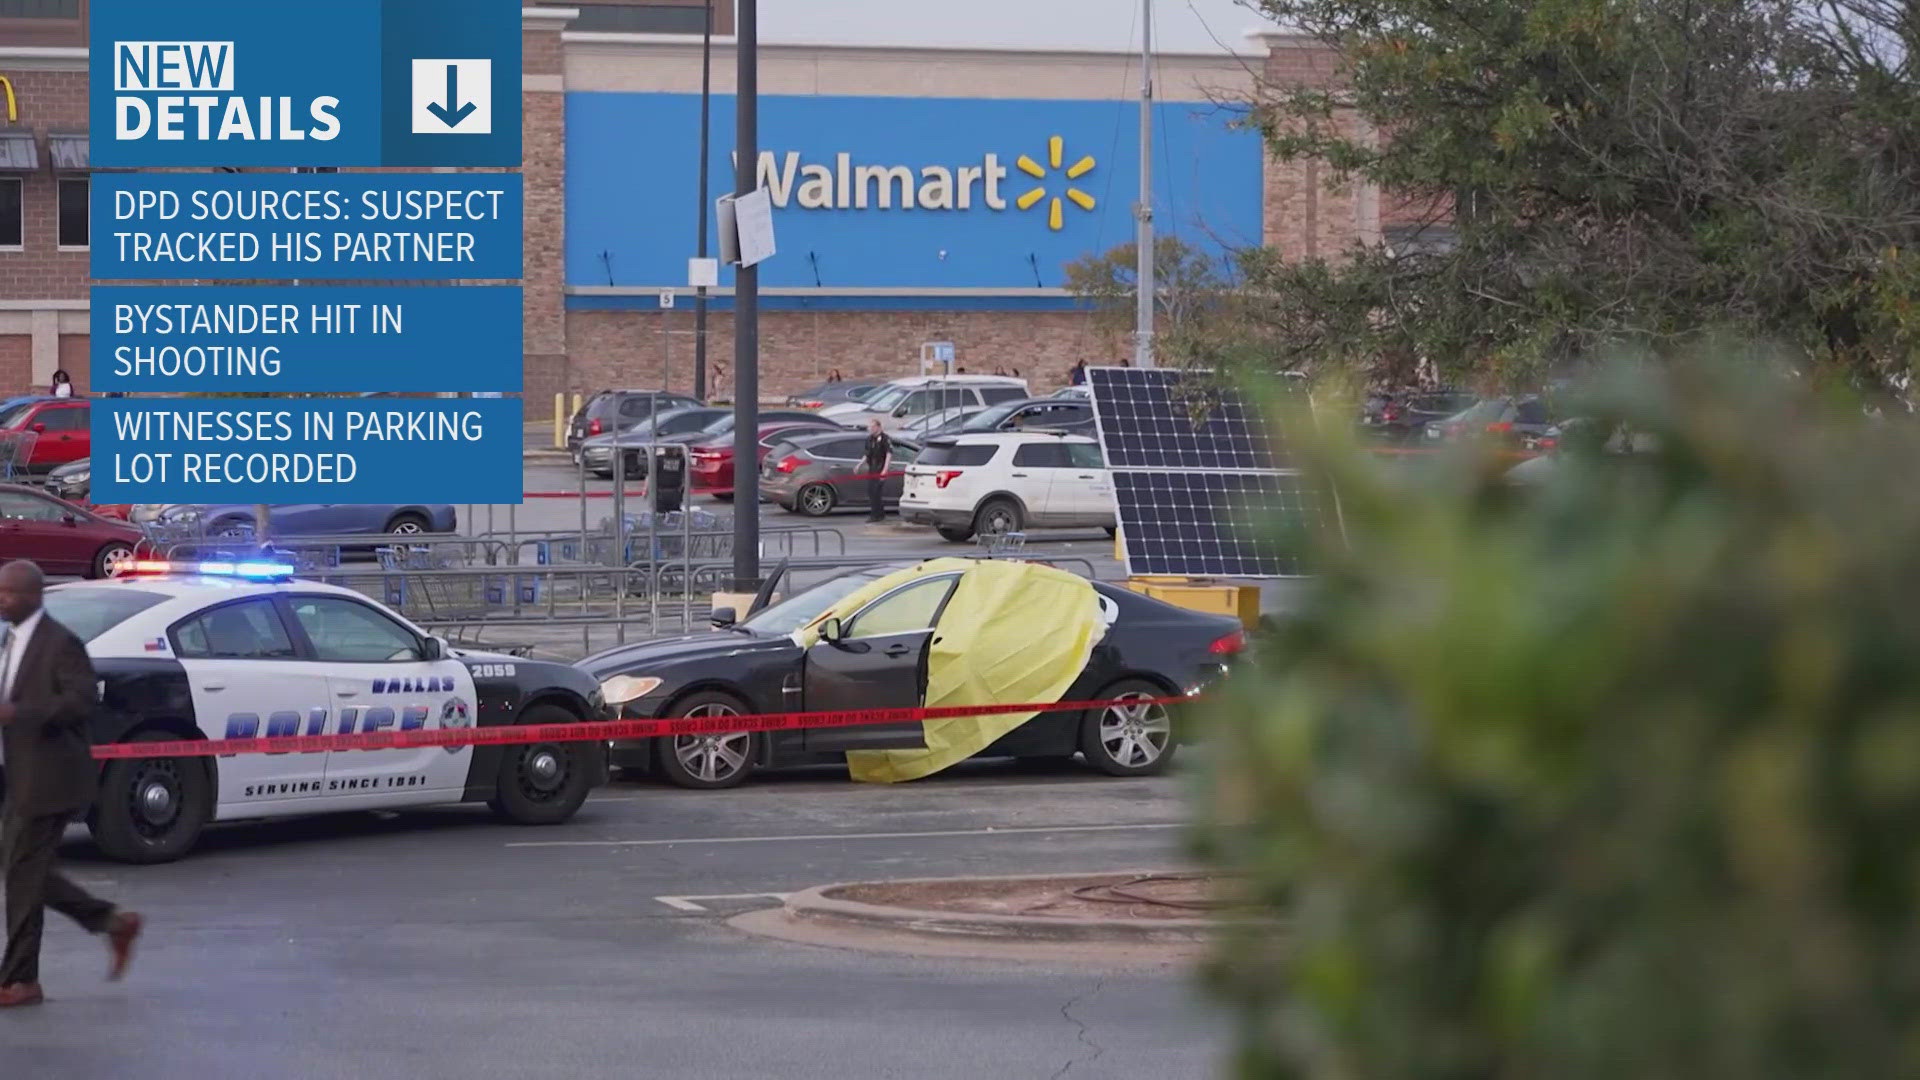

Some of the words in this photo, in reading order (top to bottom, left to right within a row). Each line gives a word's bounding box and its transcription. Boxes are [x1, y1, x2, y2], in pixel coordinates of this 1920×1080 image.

[732, 150, 1006, 209] Walmart
[372, 676, 455, 694] DALLAS
[220, 706, 429, 758] POLICE
[245, 781, 321, 796] SERVING
[329, 777, 380, 790] SINCE
